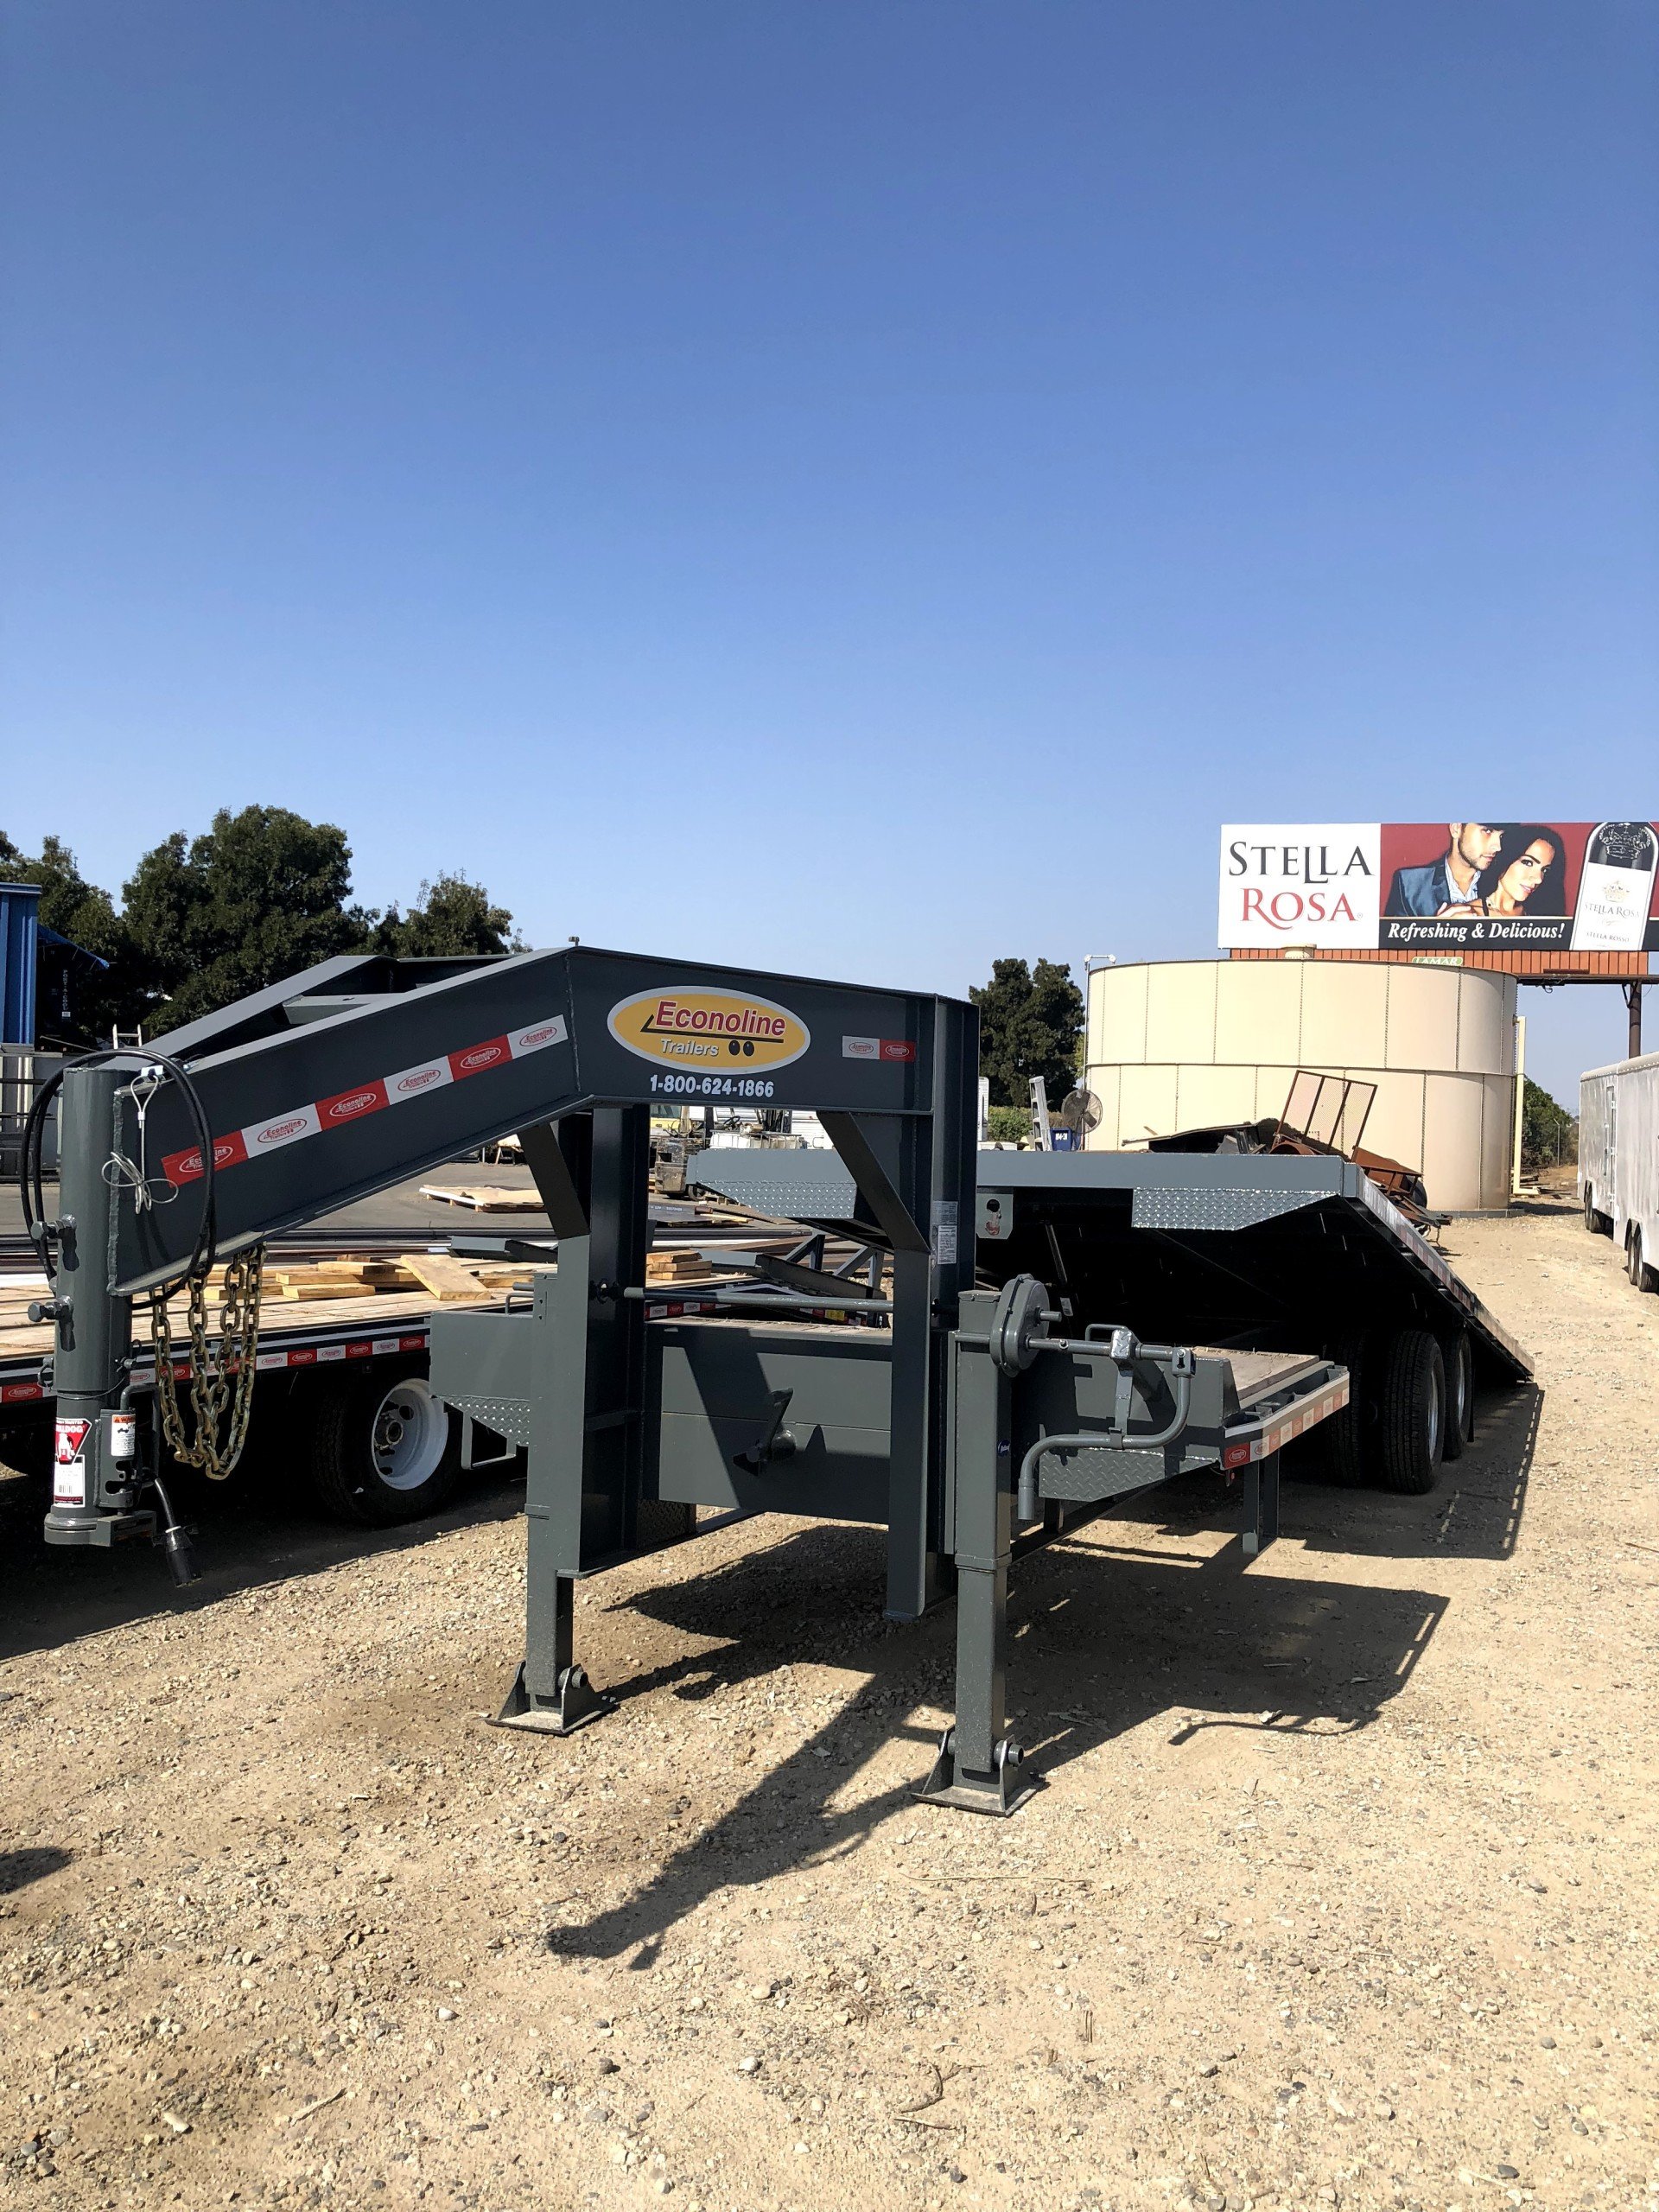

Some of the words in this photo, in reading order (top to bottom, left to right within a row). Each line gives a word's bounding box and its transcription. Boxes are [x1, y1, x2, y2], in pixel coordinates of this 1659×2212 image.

[1229, 841, 1375, 884] STELLA
[1240, 887, 1357, 931] ROSA
[1585, 902, 1614, 916] STELLA
[1388, 922, 1468, 942] Refreshing
[1471, 922, 1485, 938] &
[1489, 923, 1566, 938] Delicious!
[656, 1000, 786, 1037] Econoline
[660, 1039, 720, 1057] Trailers
[650, 1074, 774, 1098] 1-800-624-1866
[266, 1120, 302, 1136] Econoline
